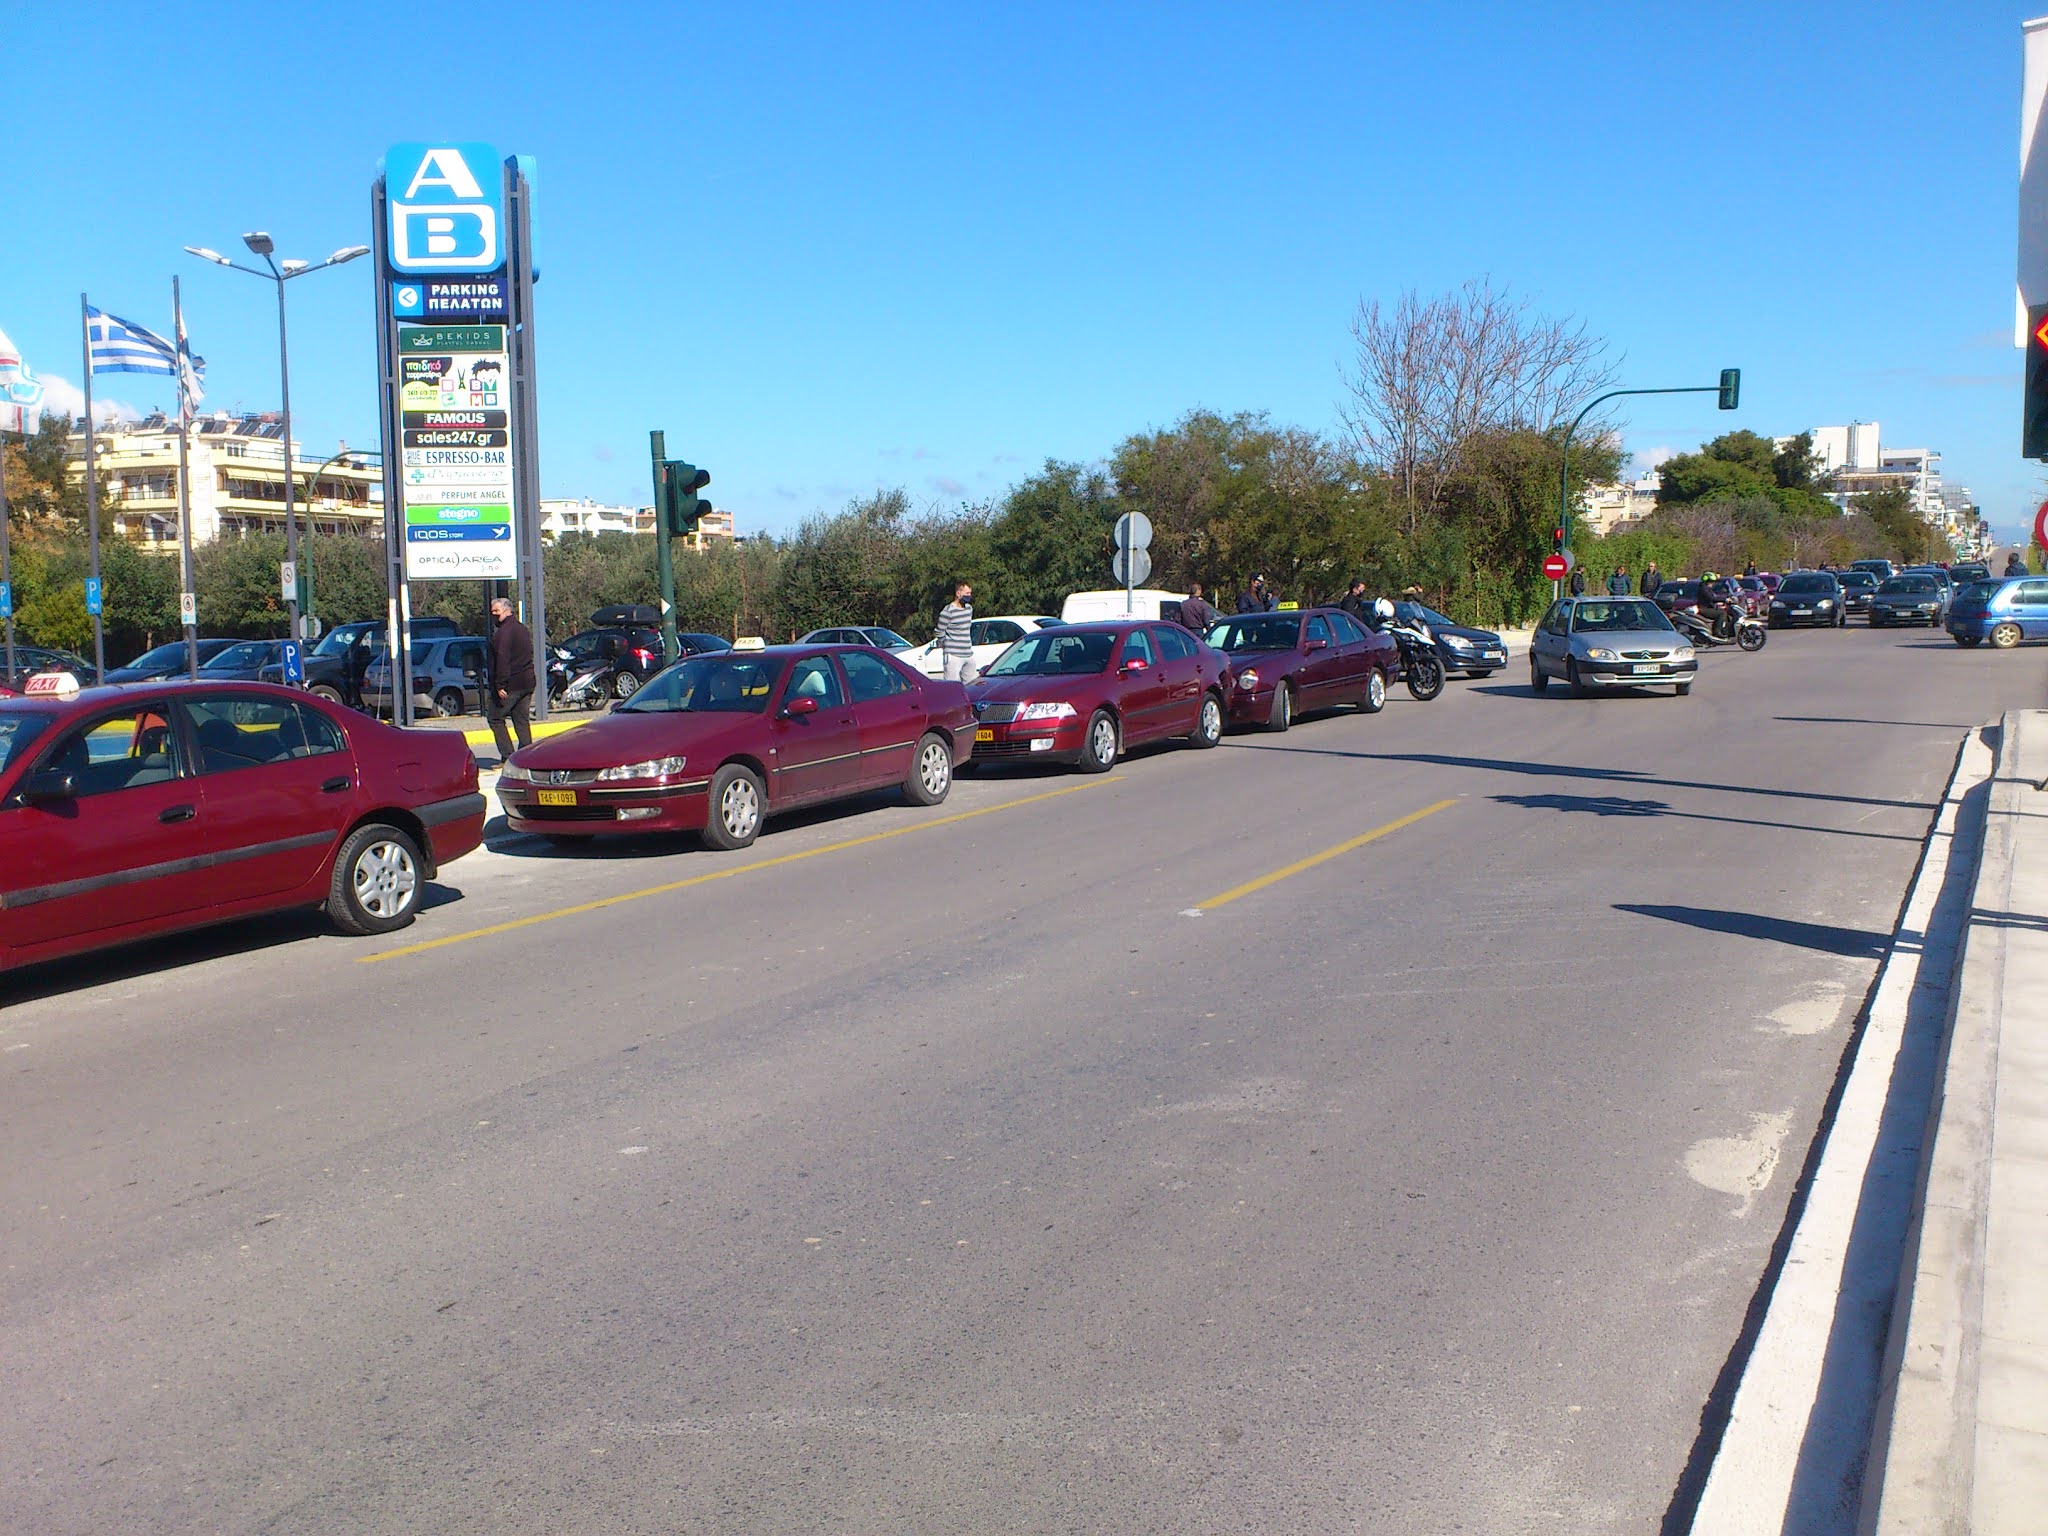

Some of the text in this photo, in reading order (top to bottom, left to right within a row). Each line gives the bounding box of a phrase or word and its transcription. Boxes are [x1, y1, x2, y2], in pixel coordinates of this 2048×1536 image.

[431, 284, 499, 295] PARKING
[428, 298, 503, 309] ΠΕΛΑΤΩΝ
[436, 332, 490, 340] BEKIDS
[406, 360, 441, 371] παιδικό
[426, 412, 486, 424] FAMOUS
[416, 430, 493, 446] sales247.gr
[438, 508, 479, 520] stegno
[414, 530, 448, 540] IQOS
[88, 581, 97, 597] P
[286, 645, 296, 663] P
[26, 678, 60, 691] TAXI
